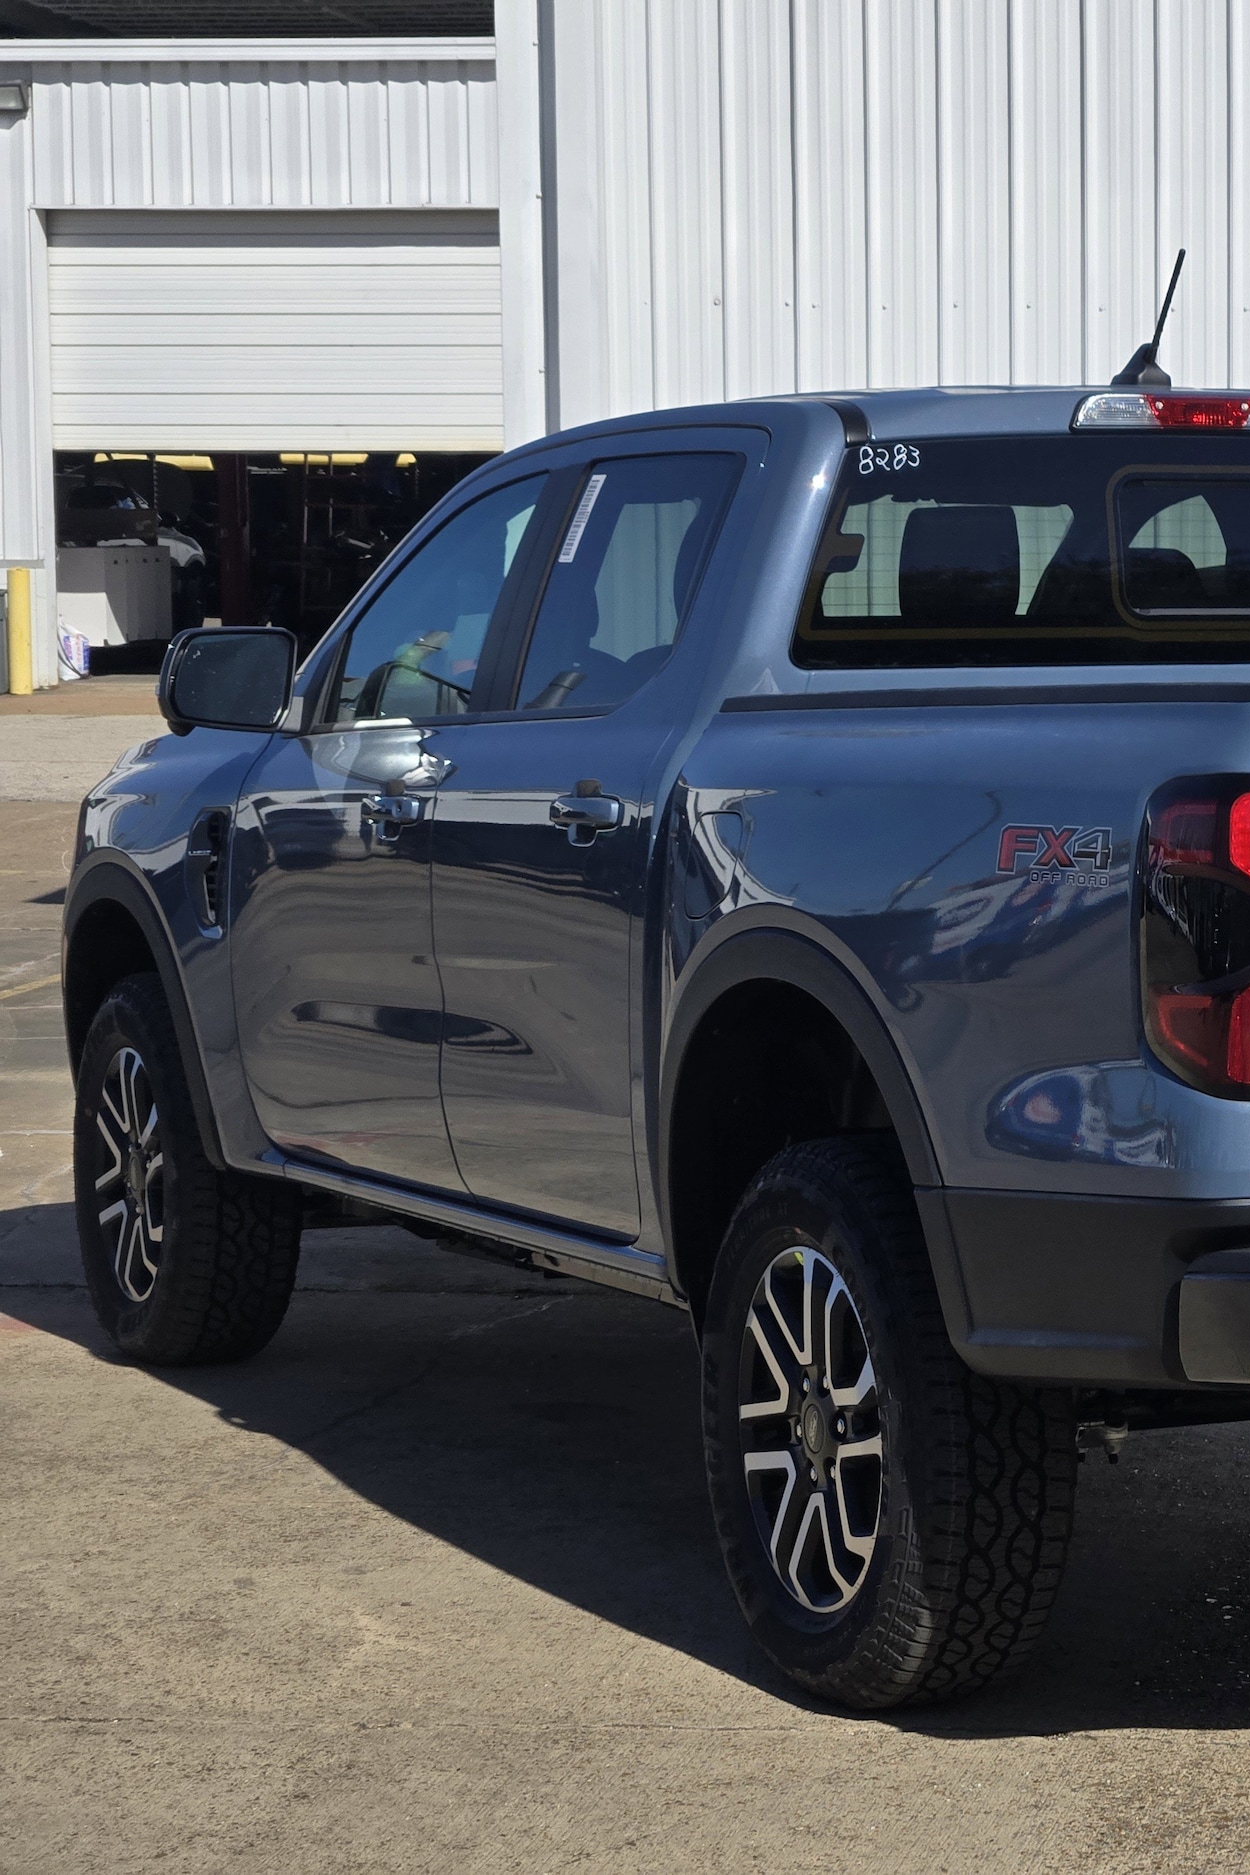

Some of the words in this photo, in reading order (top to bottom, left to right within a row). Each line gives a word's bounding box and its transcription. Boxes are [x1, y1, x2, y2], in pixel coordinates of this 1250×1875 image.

[859, 444, 920, 474] 8283
[996, 823, 1112, 874] FX4
[1030, 870, 1061, 884] OFF
[1066, 873, 1110, 887] ROAD
